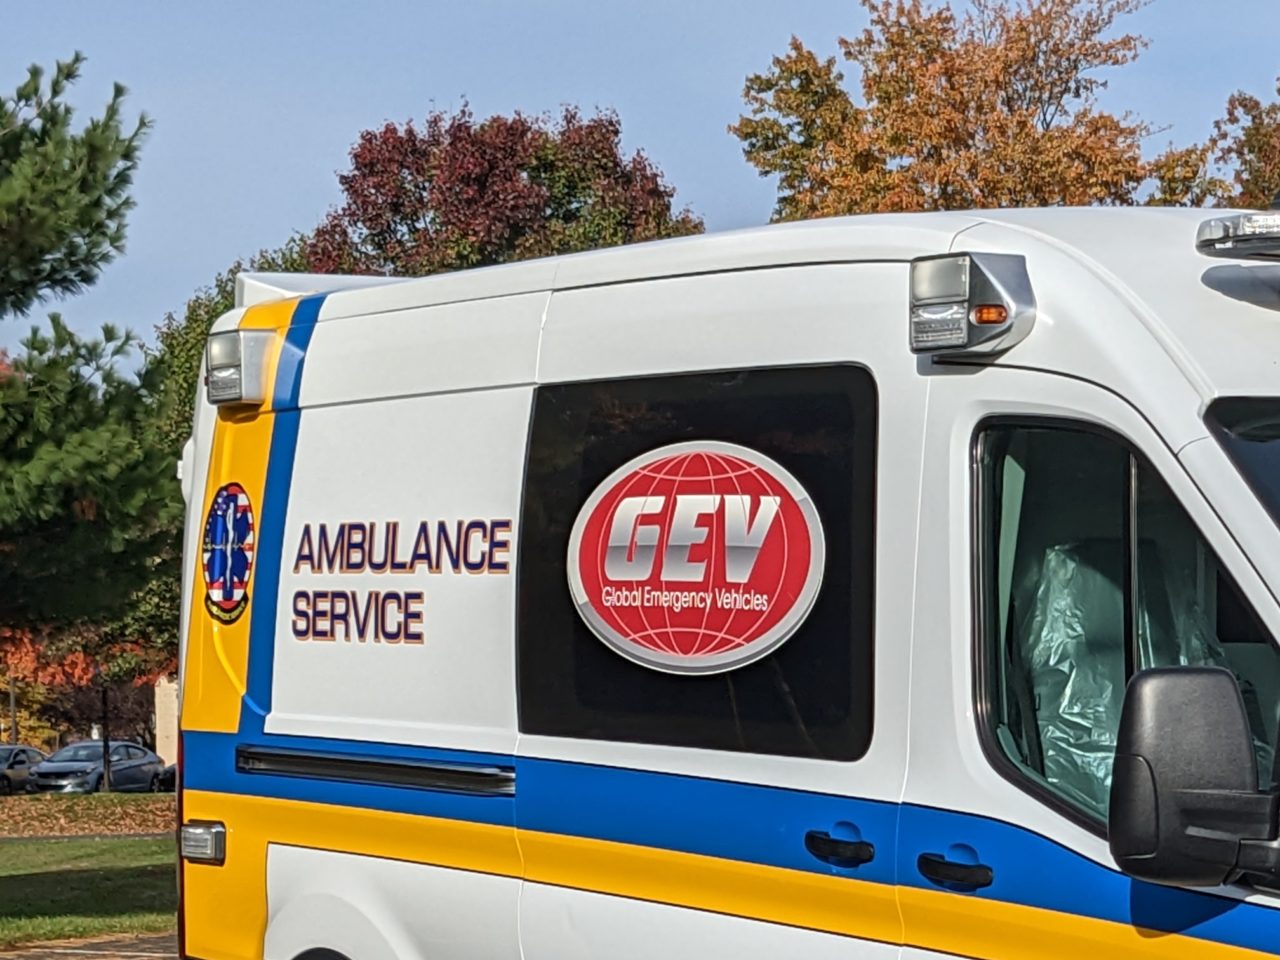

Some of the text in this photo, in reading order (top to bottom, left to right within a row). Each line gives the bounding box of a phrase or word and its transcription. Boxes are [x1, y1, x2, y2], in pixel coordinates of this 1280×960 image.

[293, 519, 512, 575] AMBULANCE
[604, 494, 781, 584] GEV
[291, 590, 424, 644] SERVICE
[602, 586, 768, 612] Global Emergency Vehicles
